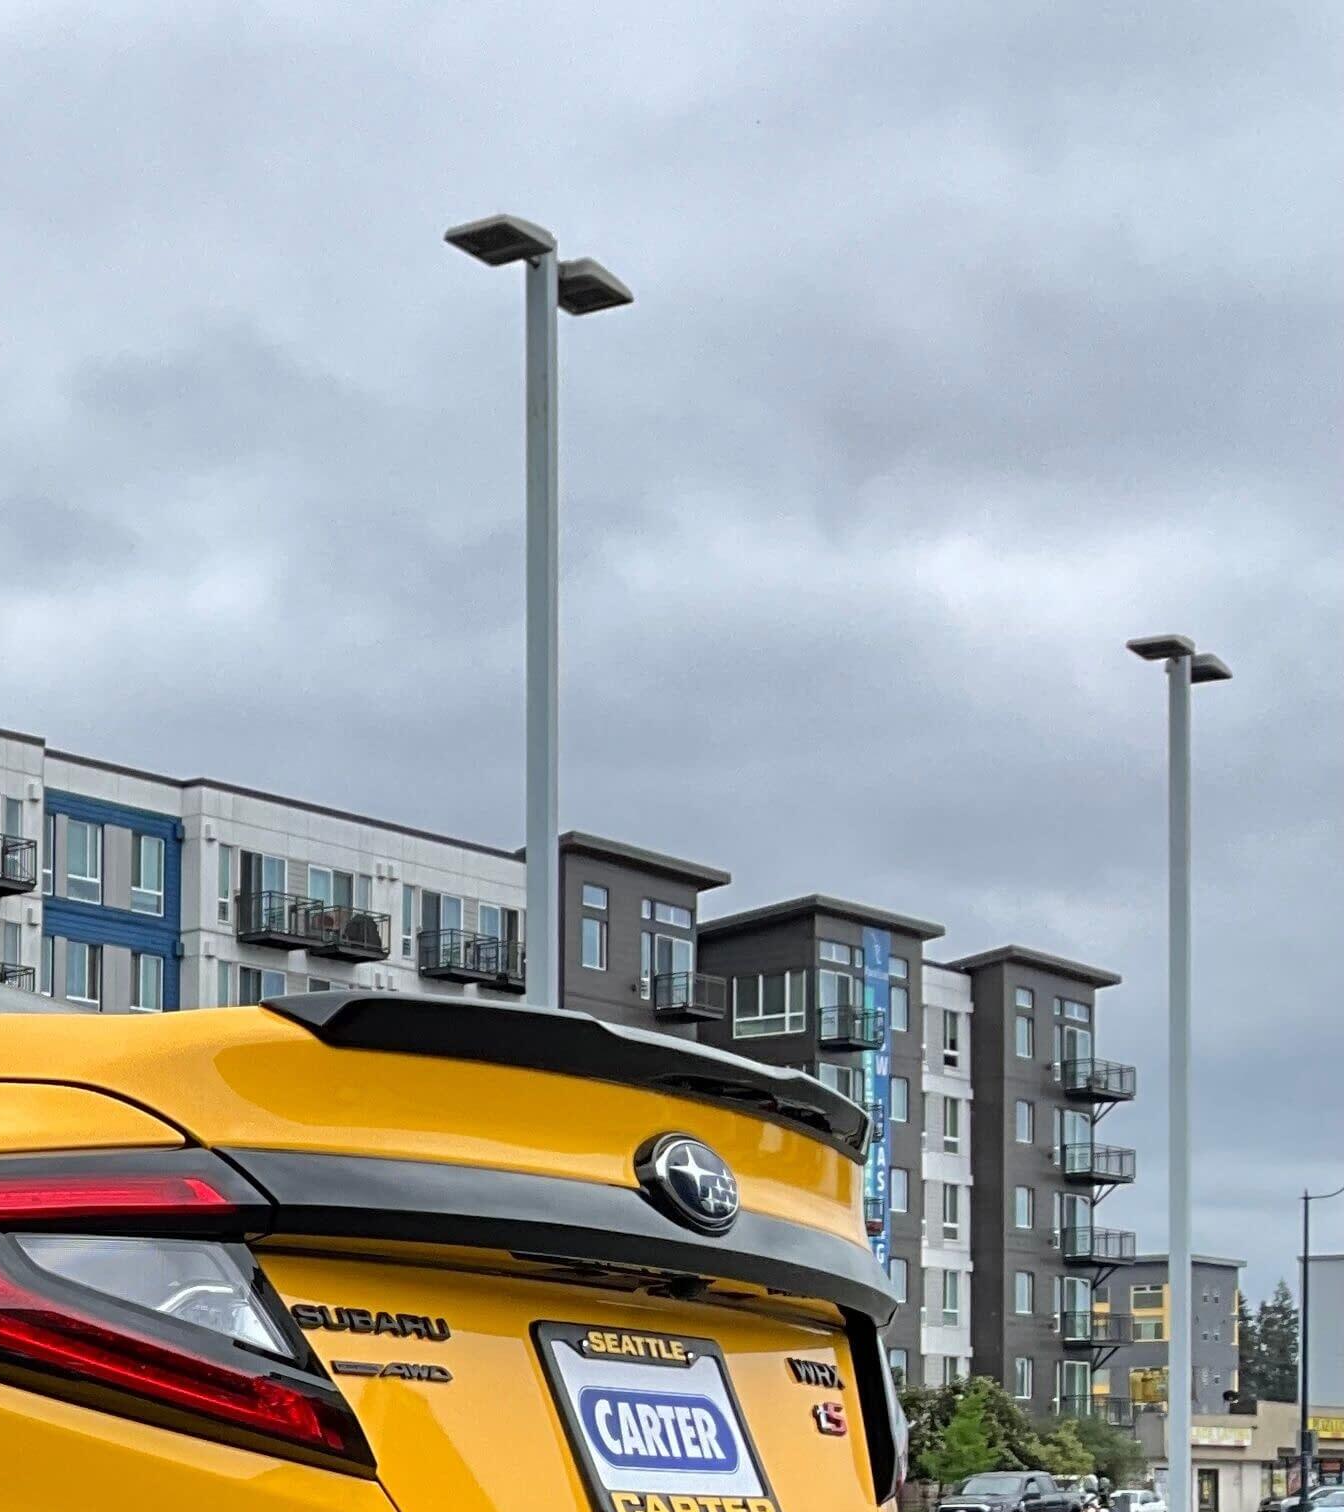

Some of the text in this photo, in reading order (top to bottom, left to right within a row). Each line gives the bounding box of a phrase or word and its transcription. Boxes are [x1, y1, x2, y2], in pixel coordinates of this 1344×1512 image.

[290, 1304, 451, 1341] SUBARU
[587, 1331, 686, 1361] SEATTLE
[379, 1362, 453, 1382] AWD
[785, 1357, 845, 1390] WRX
[594, 1398, 727, 1460] CARTER
